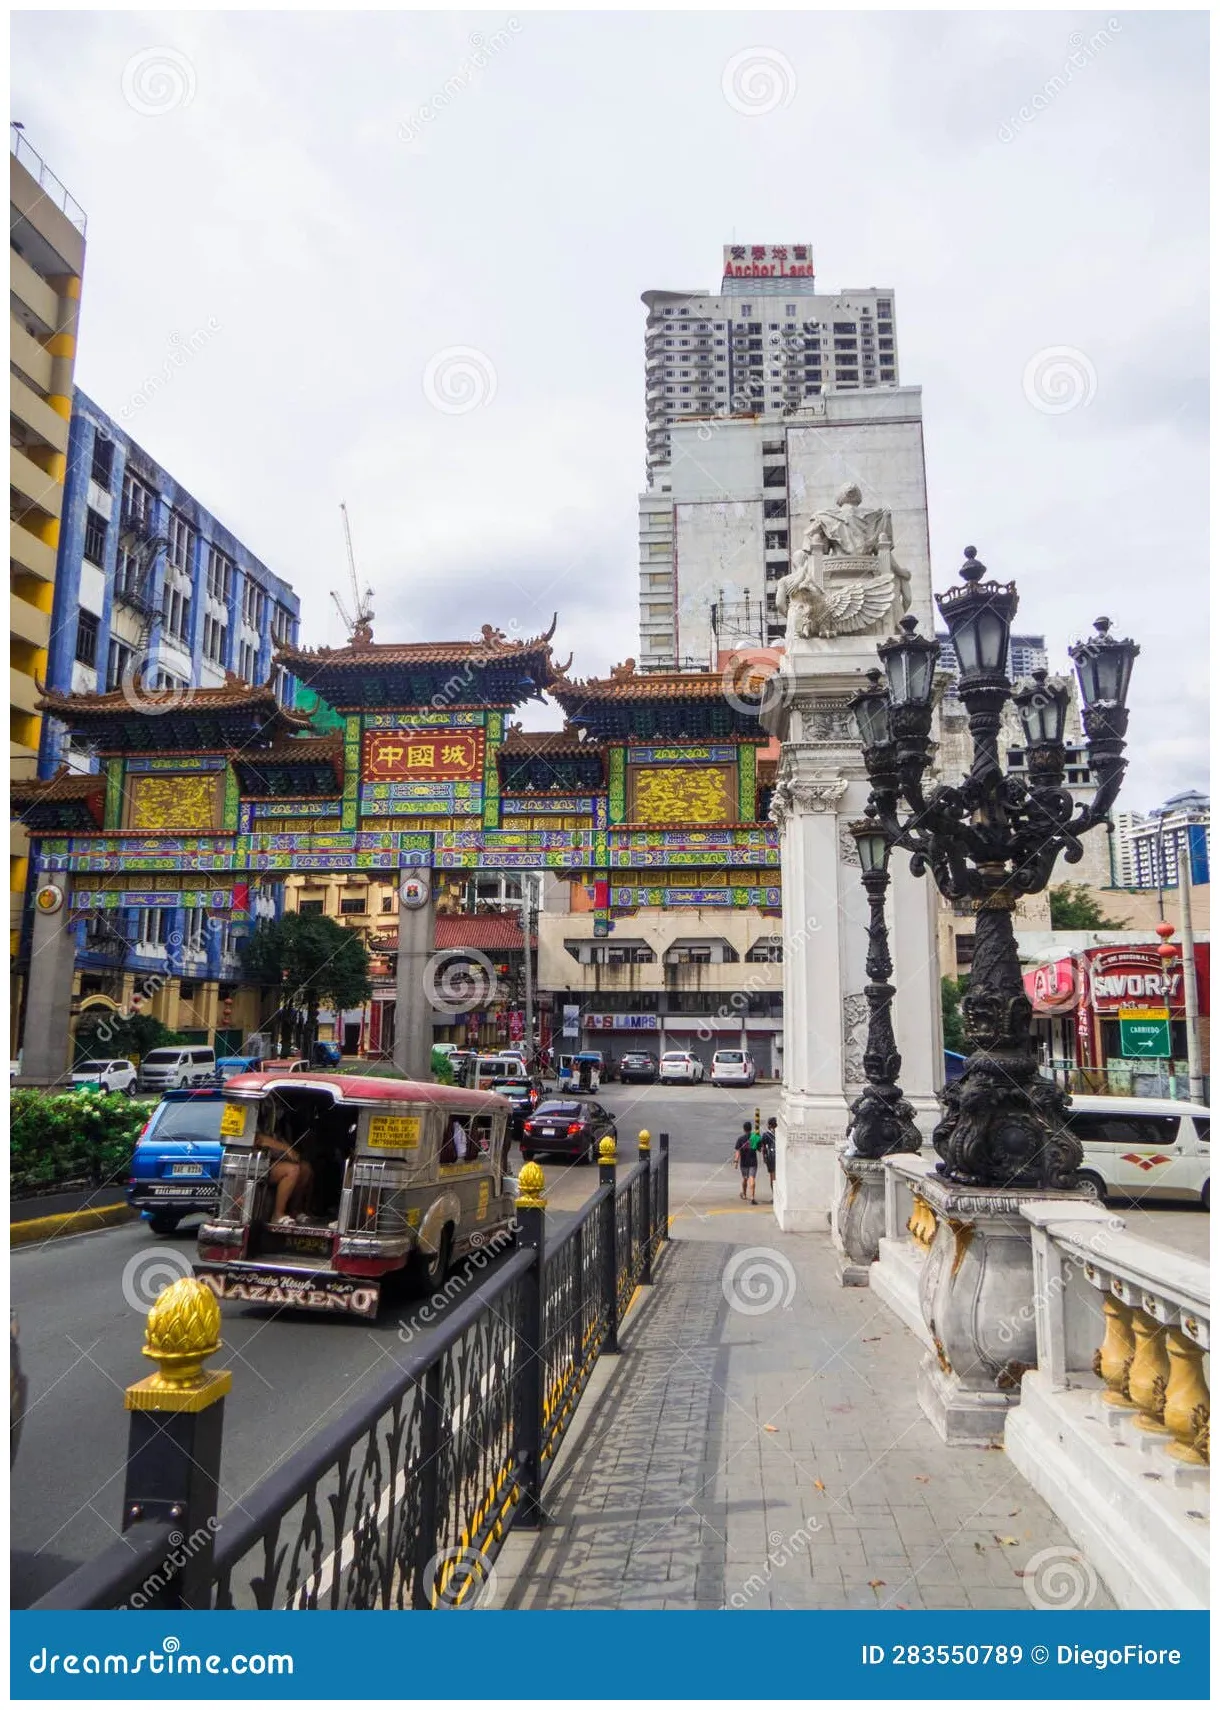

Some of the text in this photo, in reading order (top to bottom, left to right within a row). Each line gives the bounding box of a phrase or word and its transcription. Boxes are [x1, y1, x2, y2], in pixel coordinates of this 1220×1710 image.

[724, 260, 814, 277] Anchor Land
[377, 744, 469, 768] 中國城
[1094, 973, 1181, 997] SAVORY
[616, 1016, 656, 1028] LAMPS
[197, 1273, 378, 1313] NAZARENO
